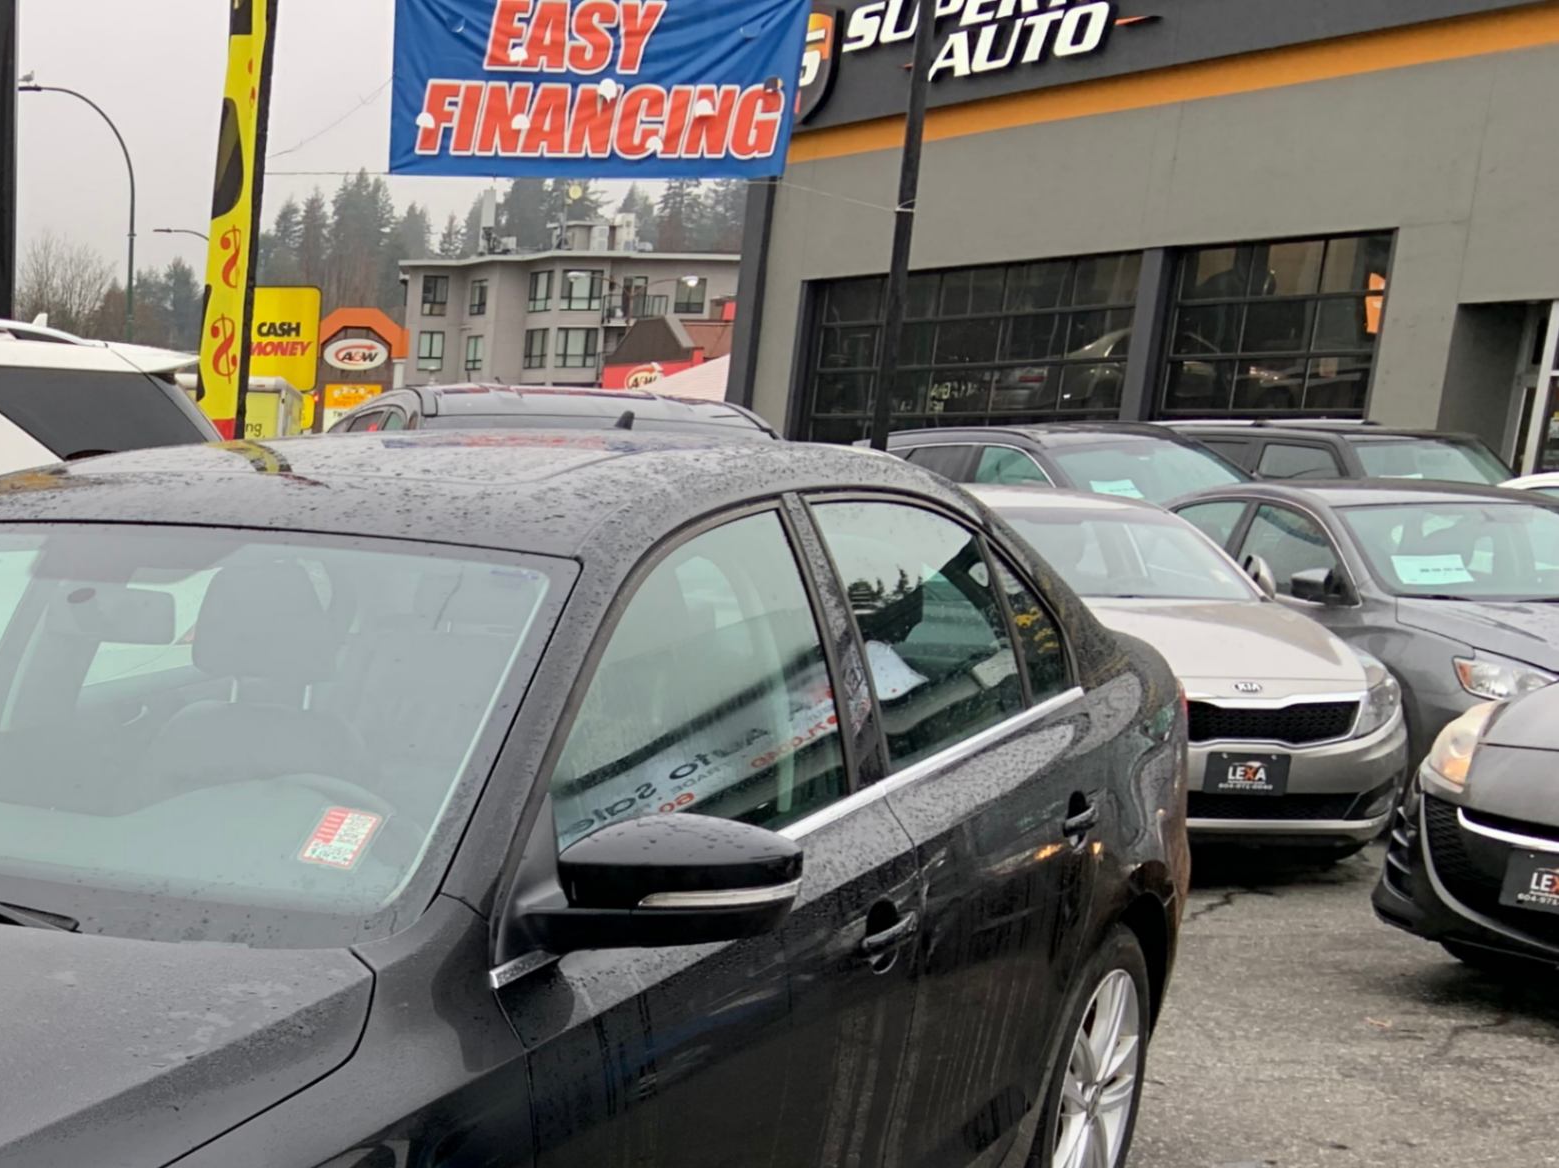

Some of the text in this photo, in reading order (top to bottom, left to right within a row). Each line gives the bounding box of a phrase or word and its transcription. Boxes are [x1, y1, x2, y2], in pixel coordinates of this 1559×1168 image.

[483, 0, 667, 74] EASY
[928, 1, 1110, 82] AUTO
[415, 78, 785, 161] FINANCING
[257, 322, 301, 337] CASH
[1237, 682, 1262, 692] KIA
[1227, 765, 1267, 781] LEXA
